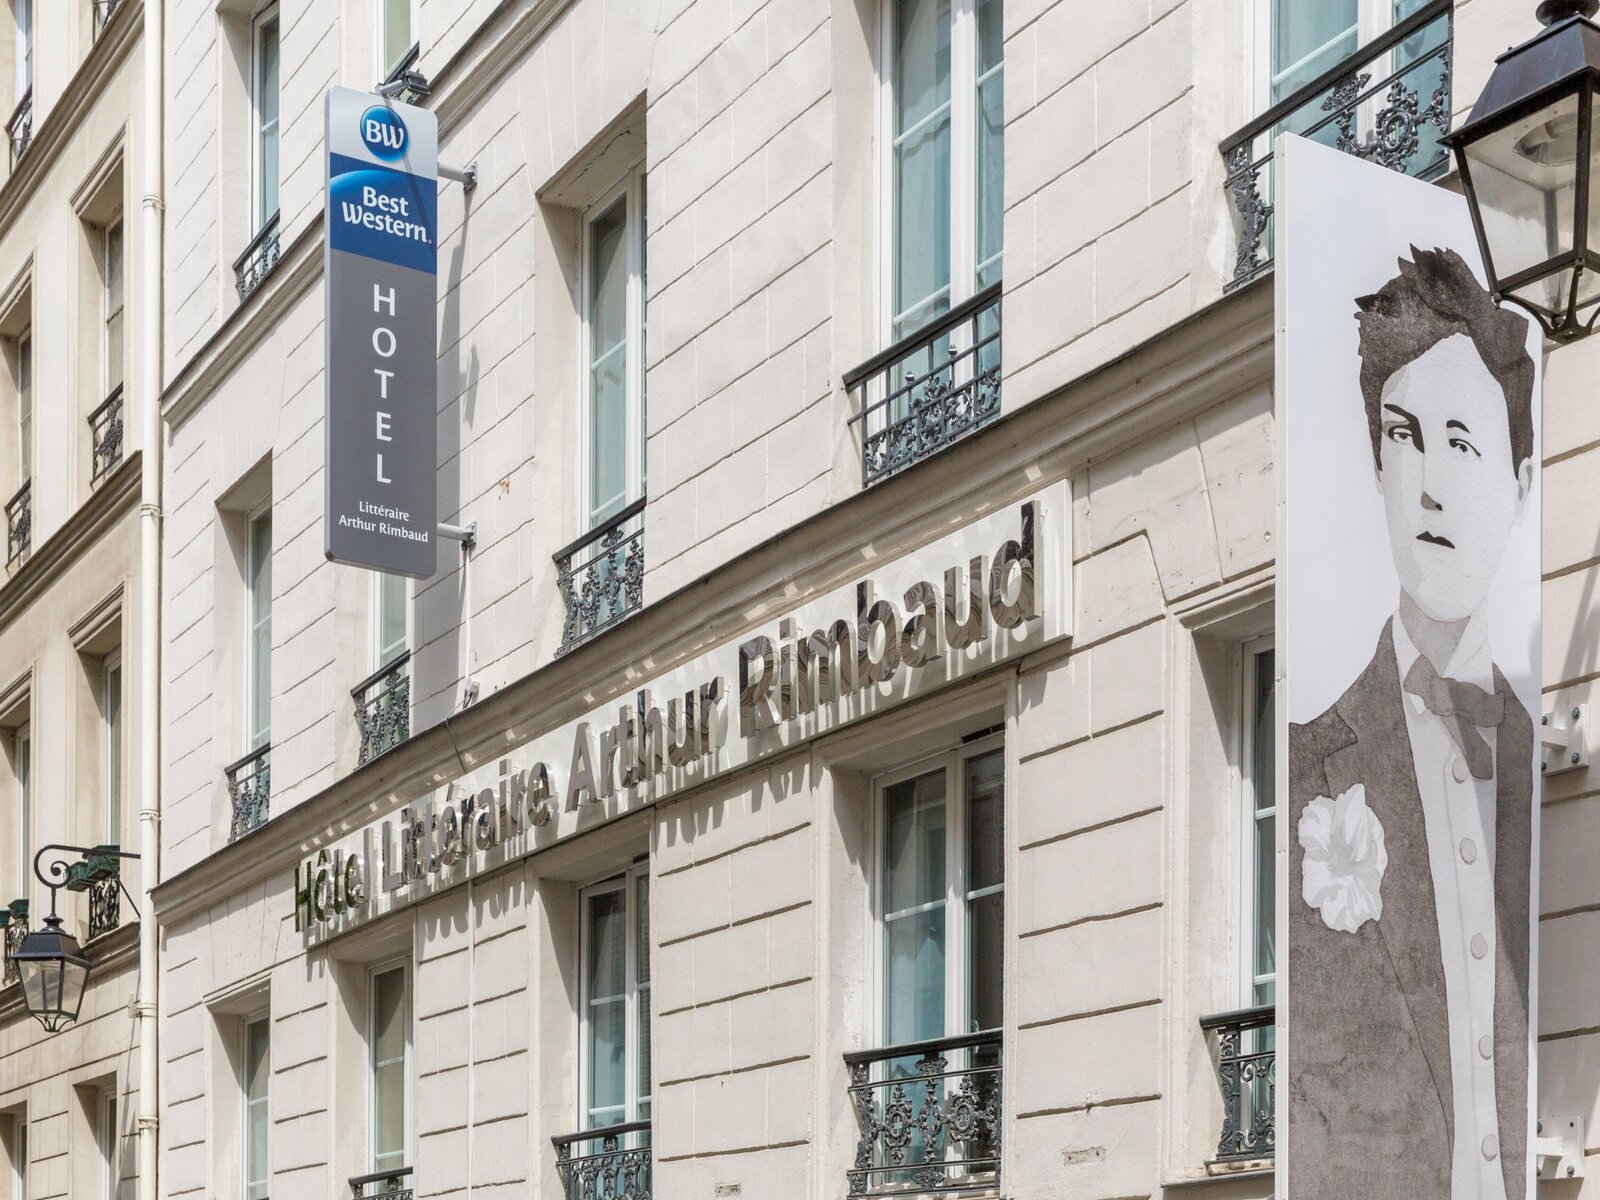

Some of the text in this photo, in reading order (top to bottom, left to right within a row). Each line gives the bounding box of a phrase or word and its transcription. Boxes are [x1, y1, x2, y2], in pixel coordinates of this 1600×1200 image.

[366, 120, 404, 149] BW
[363, 186, 409, 217] Best
[372, 284, 397, 484] HOTEL
[359, 501, 410, 522] Littéraire
[338, 515, 429, 543] Arthur Rimbaud
[295, 500, 1043, 933] Hôtel Littéraire Arthur Rimbaud
